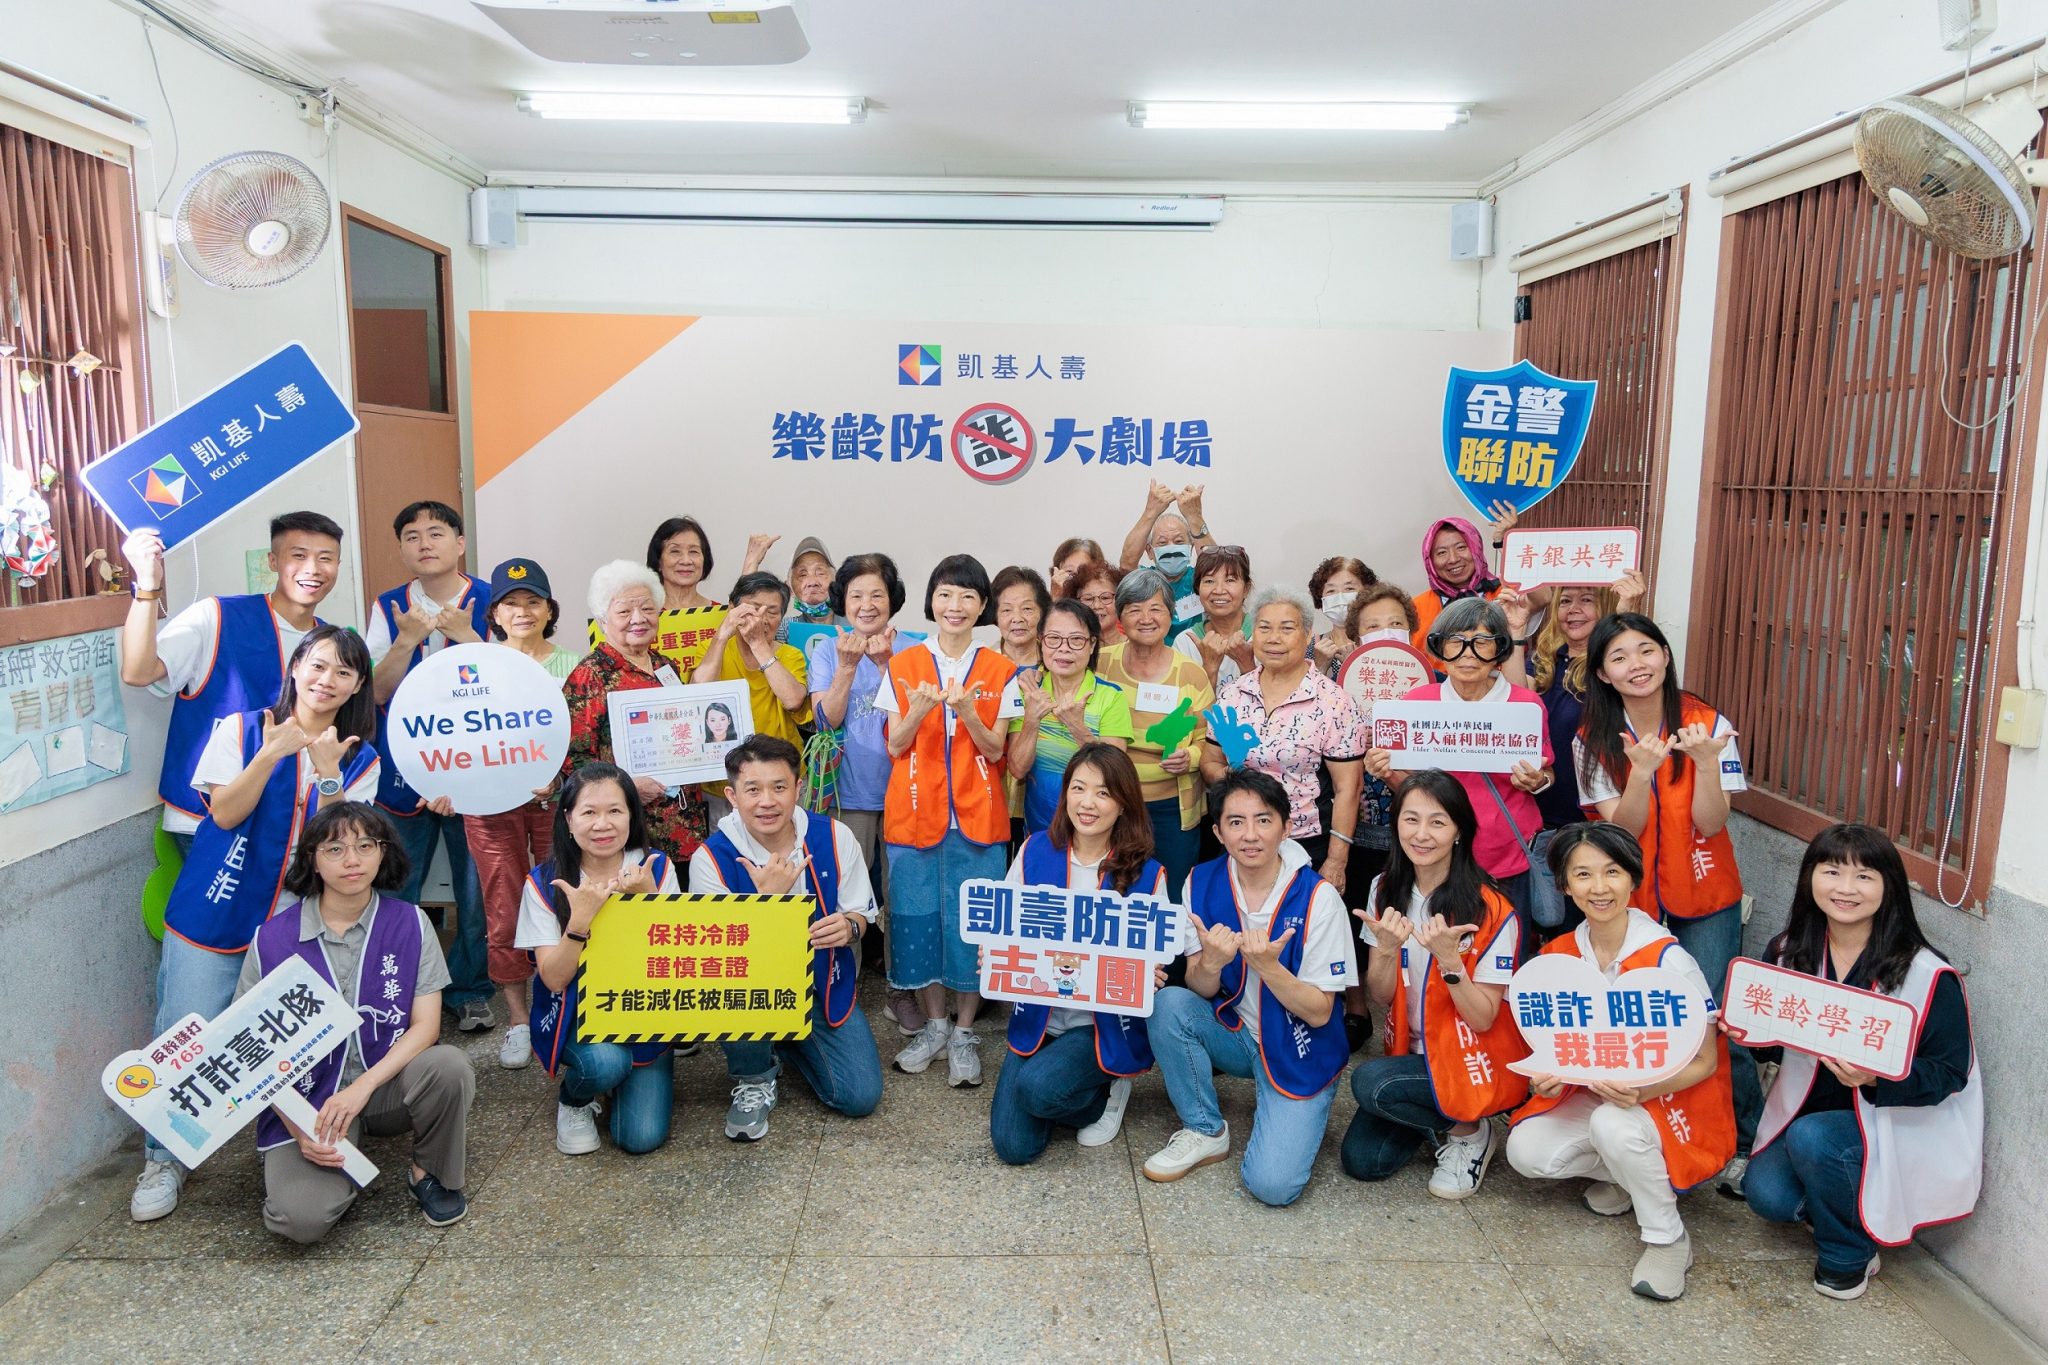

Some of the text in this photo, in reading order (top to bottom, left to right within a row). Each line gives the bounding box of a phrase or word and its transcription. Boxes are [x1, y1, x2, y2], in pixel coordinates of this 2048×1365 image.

[958, 353, 1086, 381] 凱基人壽
[1462, 383, 1568, 435] 金警
[189, 383, 306, 468] 凱基人壽
[209, 451, 251, 481] KGI LIFE
[1456, 437, 1559, 488] 聯防
[1516, 543, 1625, 569] 青銀共學
[452, 686, 491, 698] KGI LIFE
[1359, 667, 1398, 687] 樂齡
[403, 708, 553, 739] We Share
[1412, 720, 1492, 731] 社團法人中華民國
[1412, 732, 1539, 748] 老人福利關懷協會
[1500, 748, 1538, 756] Association
[419, 739, 549, 773] We Link
[967, 885, 1177, 952] 凱壽防詐
[647, 923, 750, 946] 保持冷靜
[646, 956, 749, 979] 謹慎查證
[595, 988, 797, 1012] 才能減低被騙風險
[1517, 990, 1688, 1027] 識詐 阻詐
[1743, 983, 1893, 1051] 樂齡學習
[169, 983, 325, 1118] 打詐臺北隊
[170, 1041, 204, 1071] 165
[1554, 1032, 1669, 1069] 我最行
